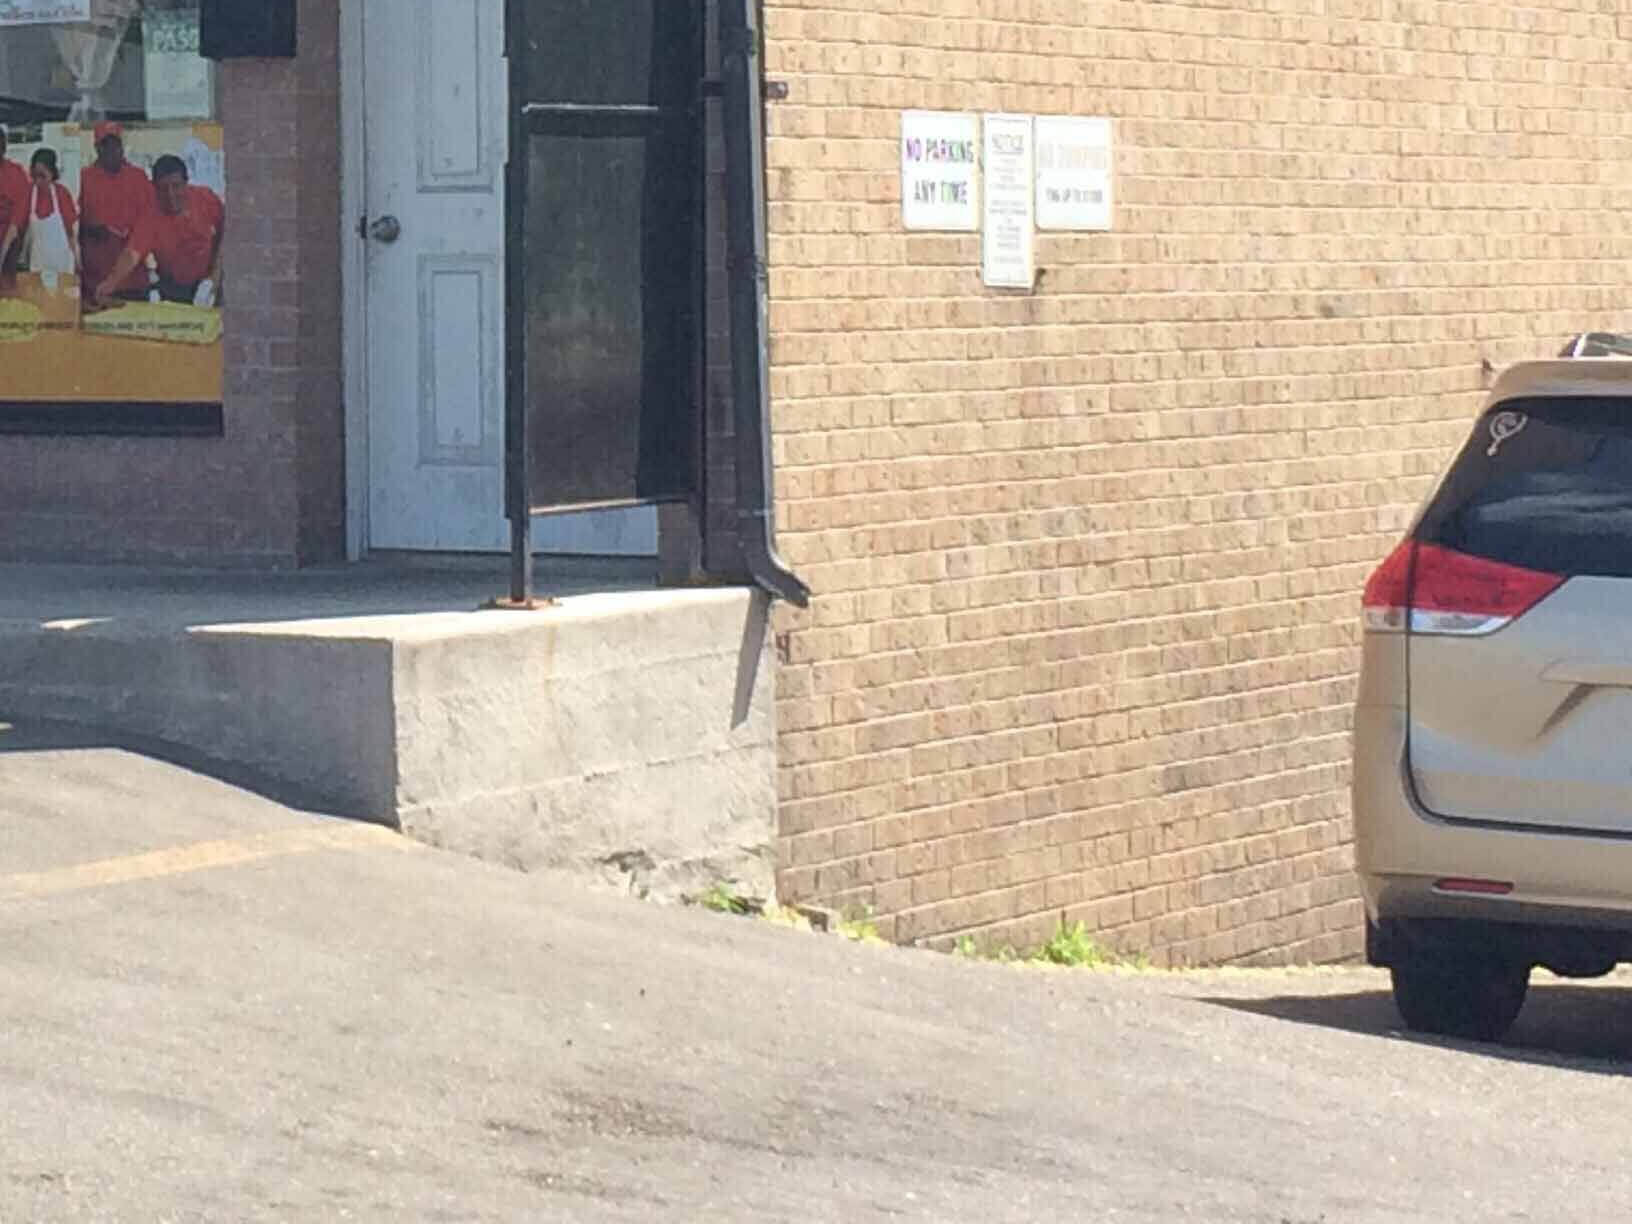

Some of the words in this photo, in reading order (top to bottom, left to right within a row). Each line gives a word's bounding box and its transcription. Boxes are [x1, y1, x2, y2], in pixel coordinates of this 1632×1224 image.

[905, 137, 922, 162] NO
[925, 137, 974, 164] PARKING
[914, 179, 936, 204] ANY
[940, 180, 968, 205] TIME
